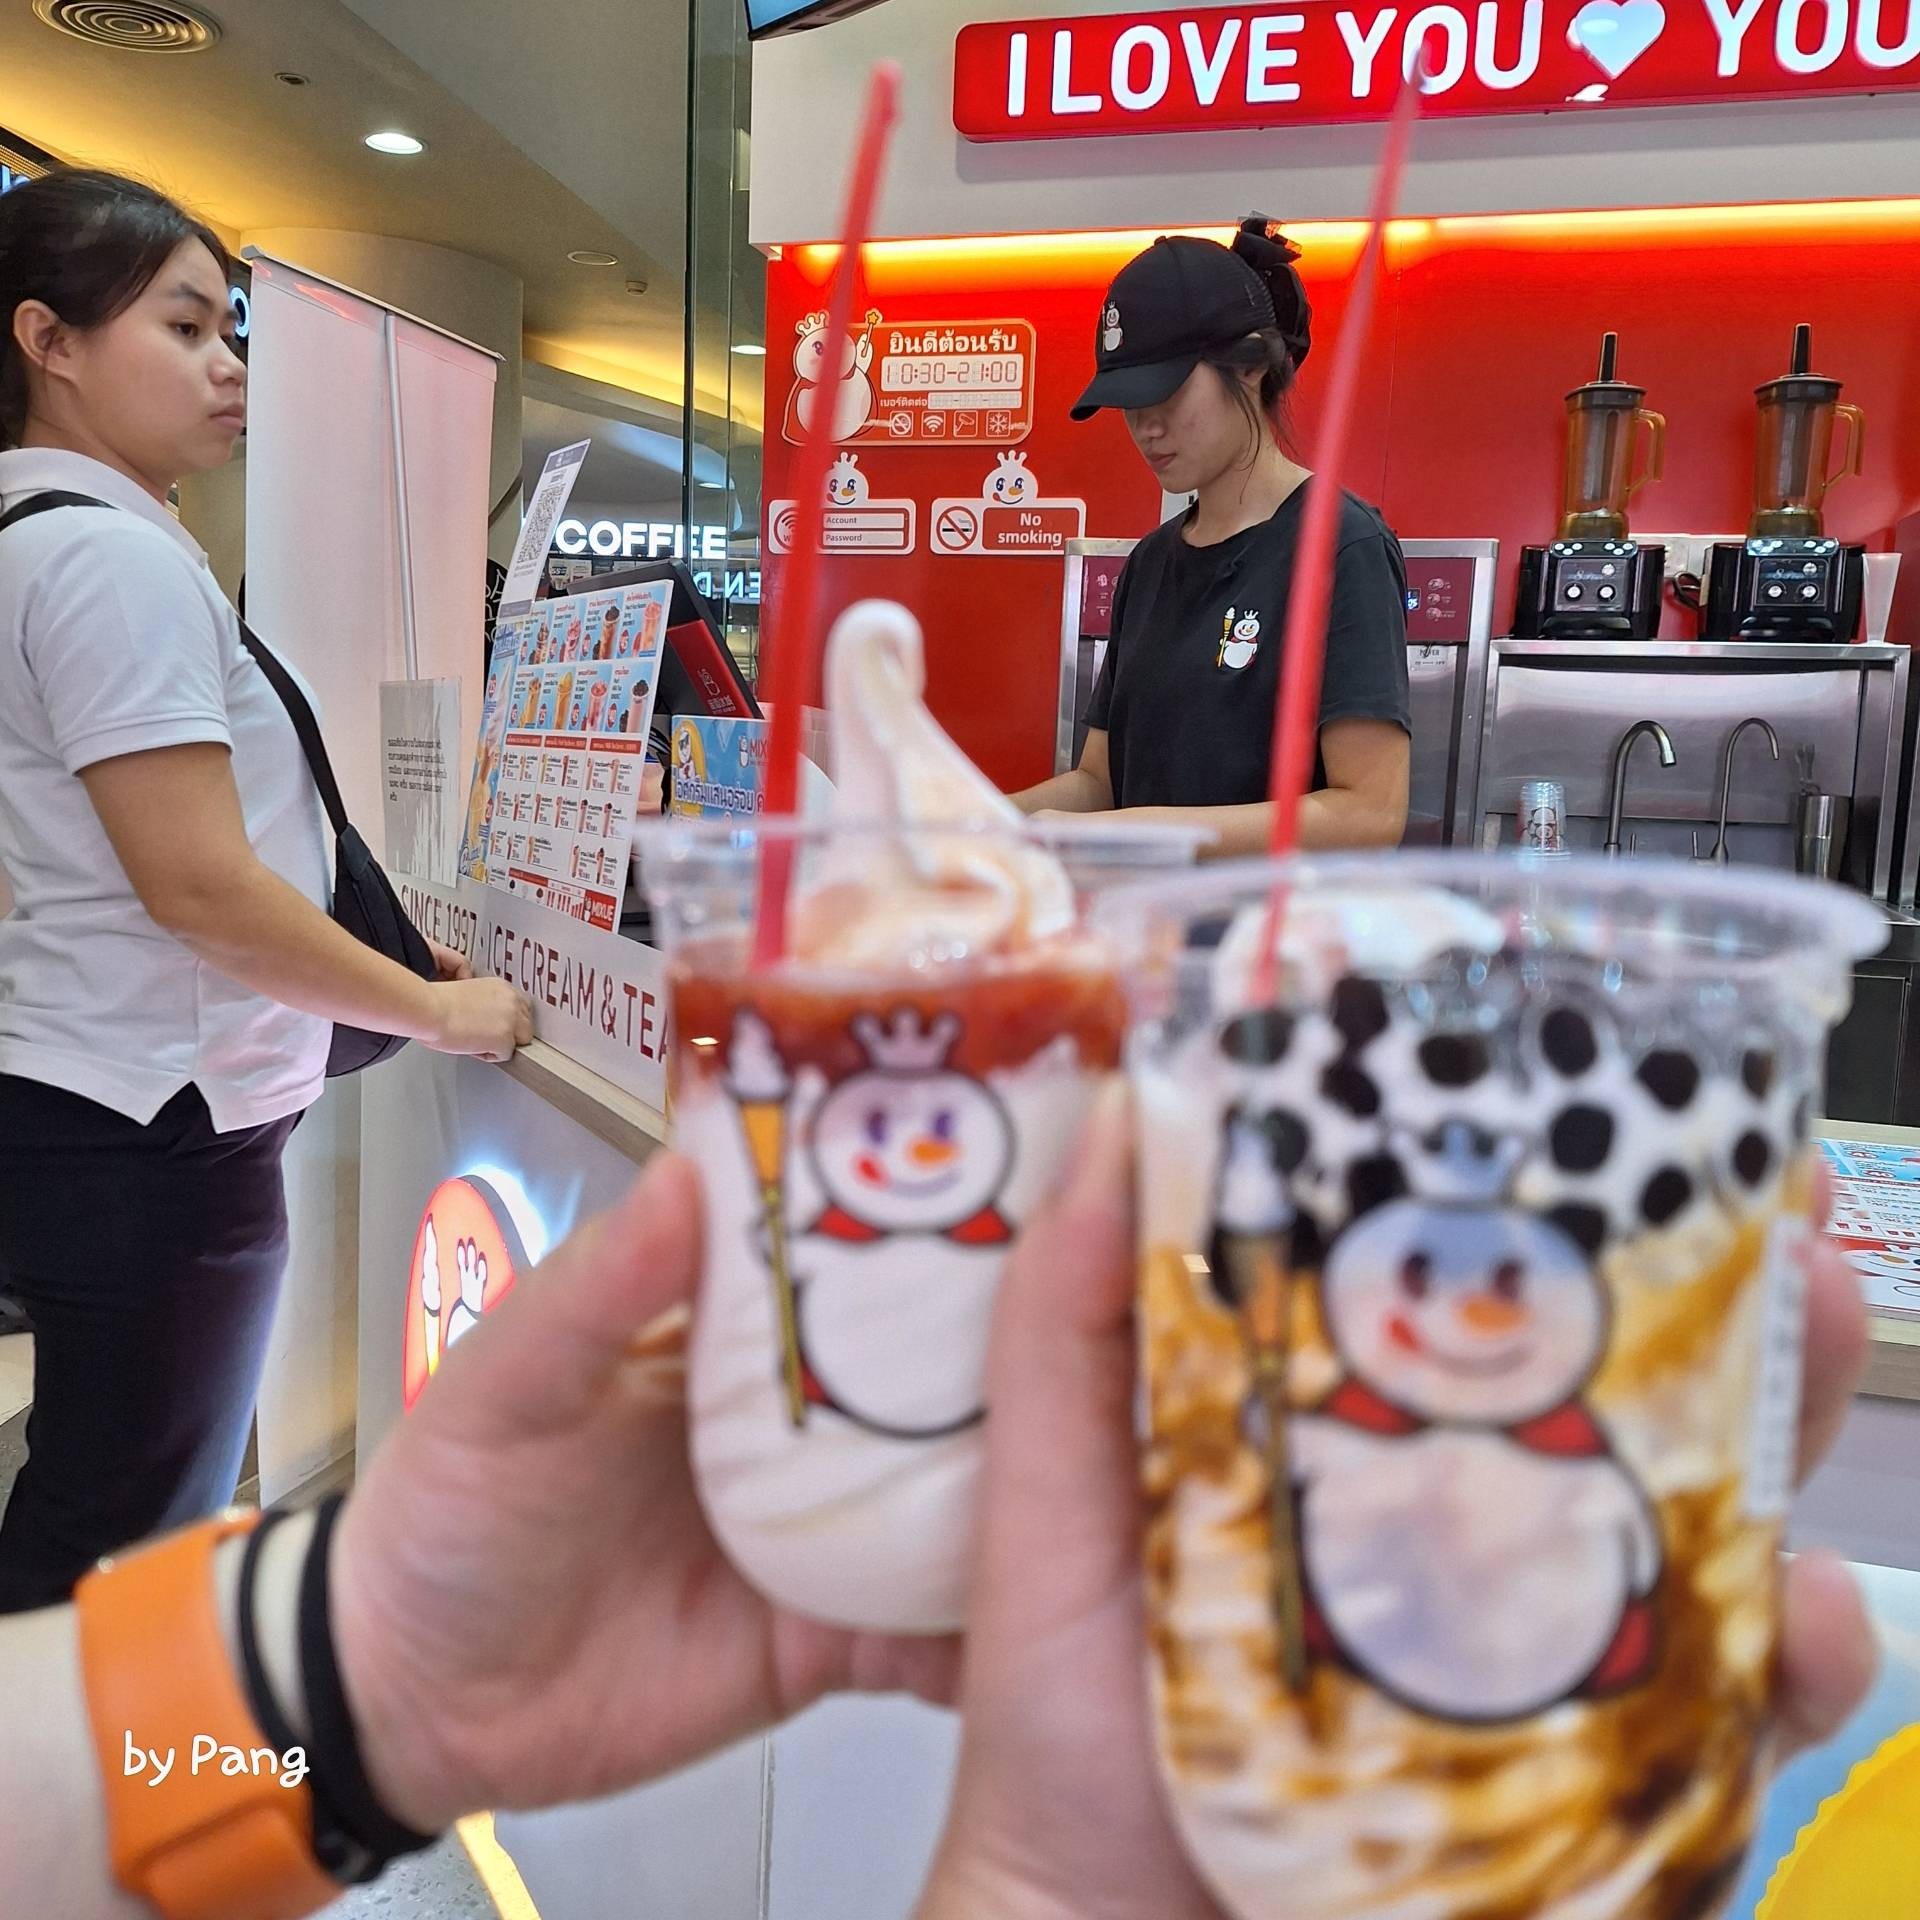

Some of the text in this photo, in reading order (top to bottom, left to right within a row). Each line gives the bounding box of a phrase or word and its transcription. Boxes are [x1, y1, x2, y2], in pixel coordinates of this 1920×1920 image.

[1007, 0, 1920, 118] I LOVE YOU YOU
[889, 329, 1018, 354] ยินดีต้อนรับ
[886, 361, 1018, 385] 10:30-21:00
[880, 396, 928, 408] เบอร์ติดต่อ
[826, 516, 857, 525] Account
[1020, 512, 1042, 526] No
[555, 519, 727, 560] COFFEE
[825, 533, 863, 542] Password
[997, 529, 1062, 547] smoking
[749, 738, 768, 757] MIX
[401, 883, 443, 941] SINCE
[445, 902, 478, 962] 1997
[487, 921, 515, 984] ICE
[520, 937, 595, 1027] CREAM
[600, 974, 617, 1039] &
